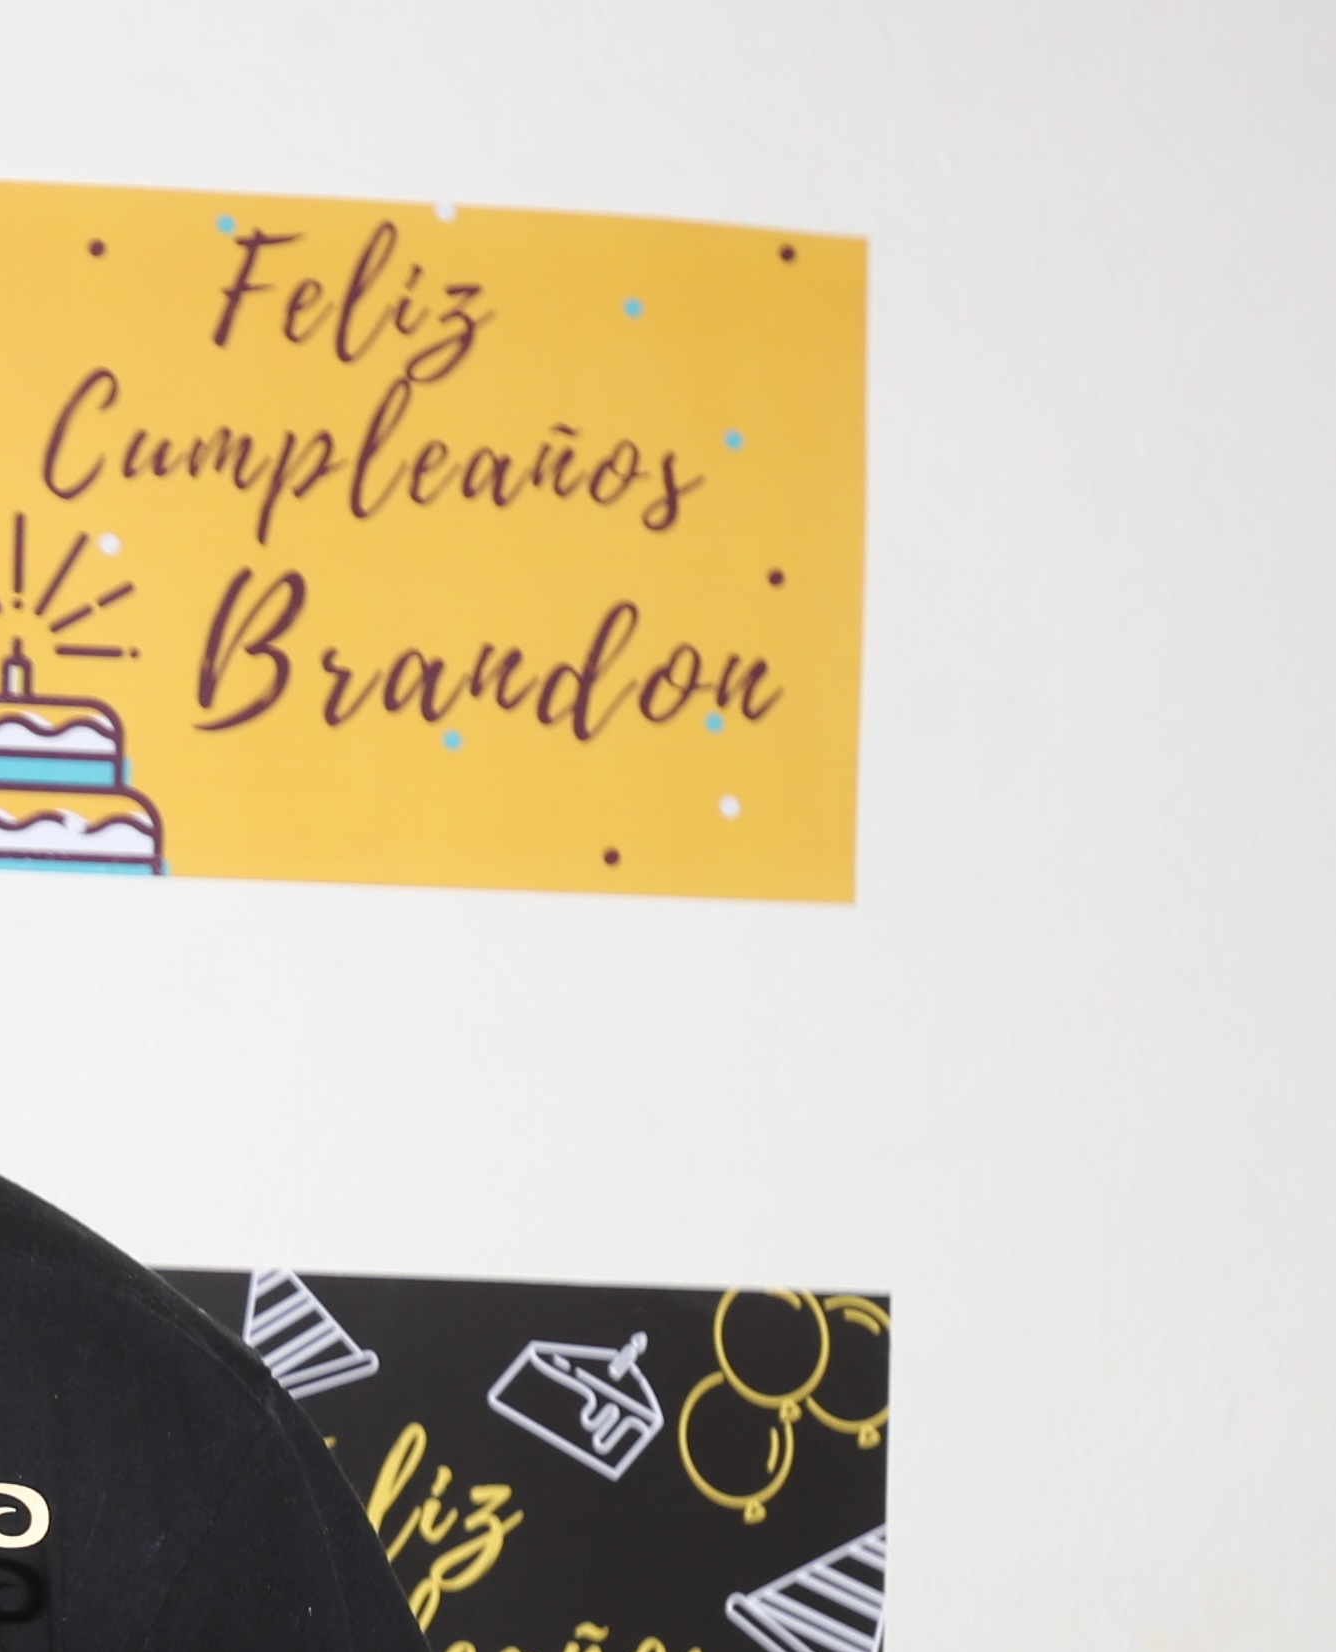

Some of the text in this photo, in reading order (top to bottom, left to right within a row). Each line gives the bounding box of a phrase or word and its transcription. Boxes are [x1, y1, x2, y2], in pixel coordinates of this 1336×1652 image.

[212, 220, 496, 382] Feliz
[40, 366, 704, 545] Cumpleaños
[192, 567, 782, 741] Brandon
[365, 1422, 524, 1592] liz
